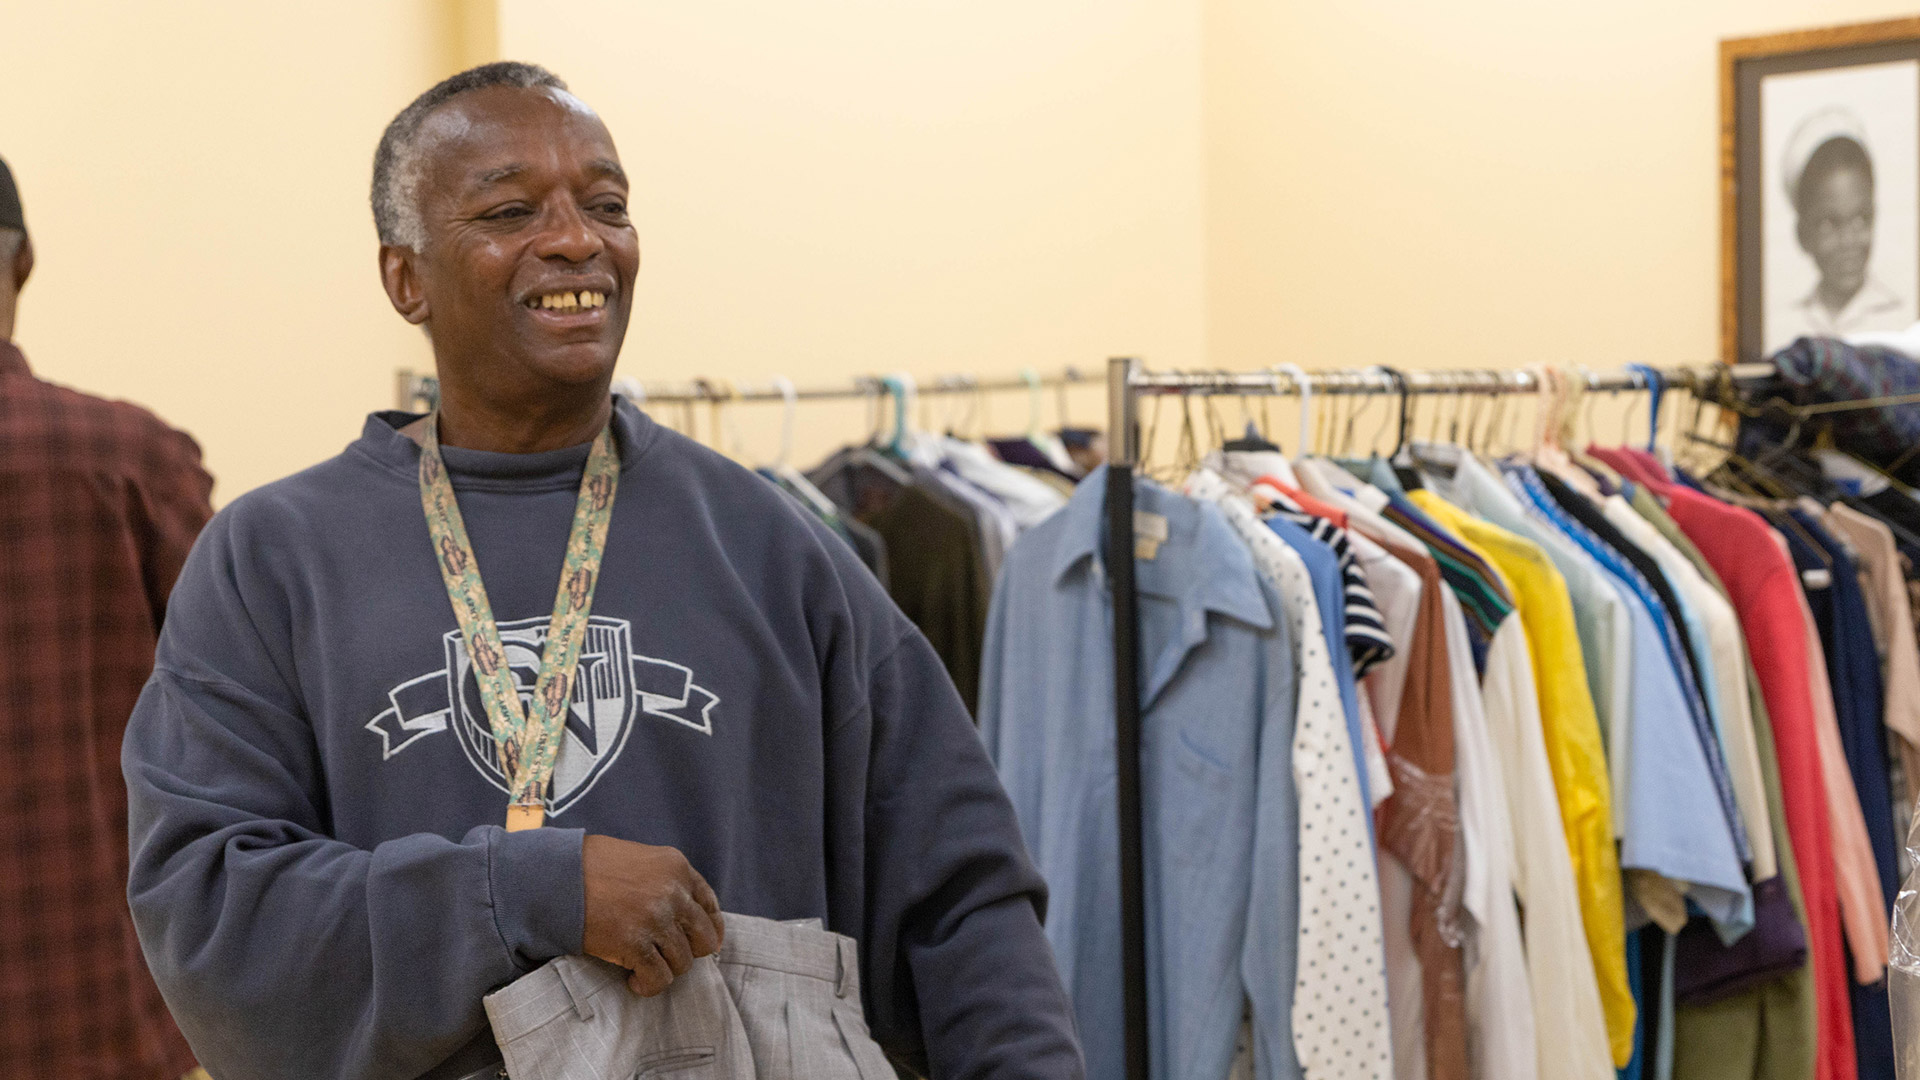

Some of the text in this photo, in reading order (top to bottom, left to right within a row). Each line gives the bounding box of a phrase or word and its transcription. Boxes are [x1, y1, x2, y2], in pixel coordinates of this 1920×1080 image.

[464, 595, 479, 620] ARMY
[496, 697, 512, 724] ARMY
[535, 731, 549, 758] ARMY
